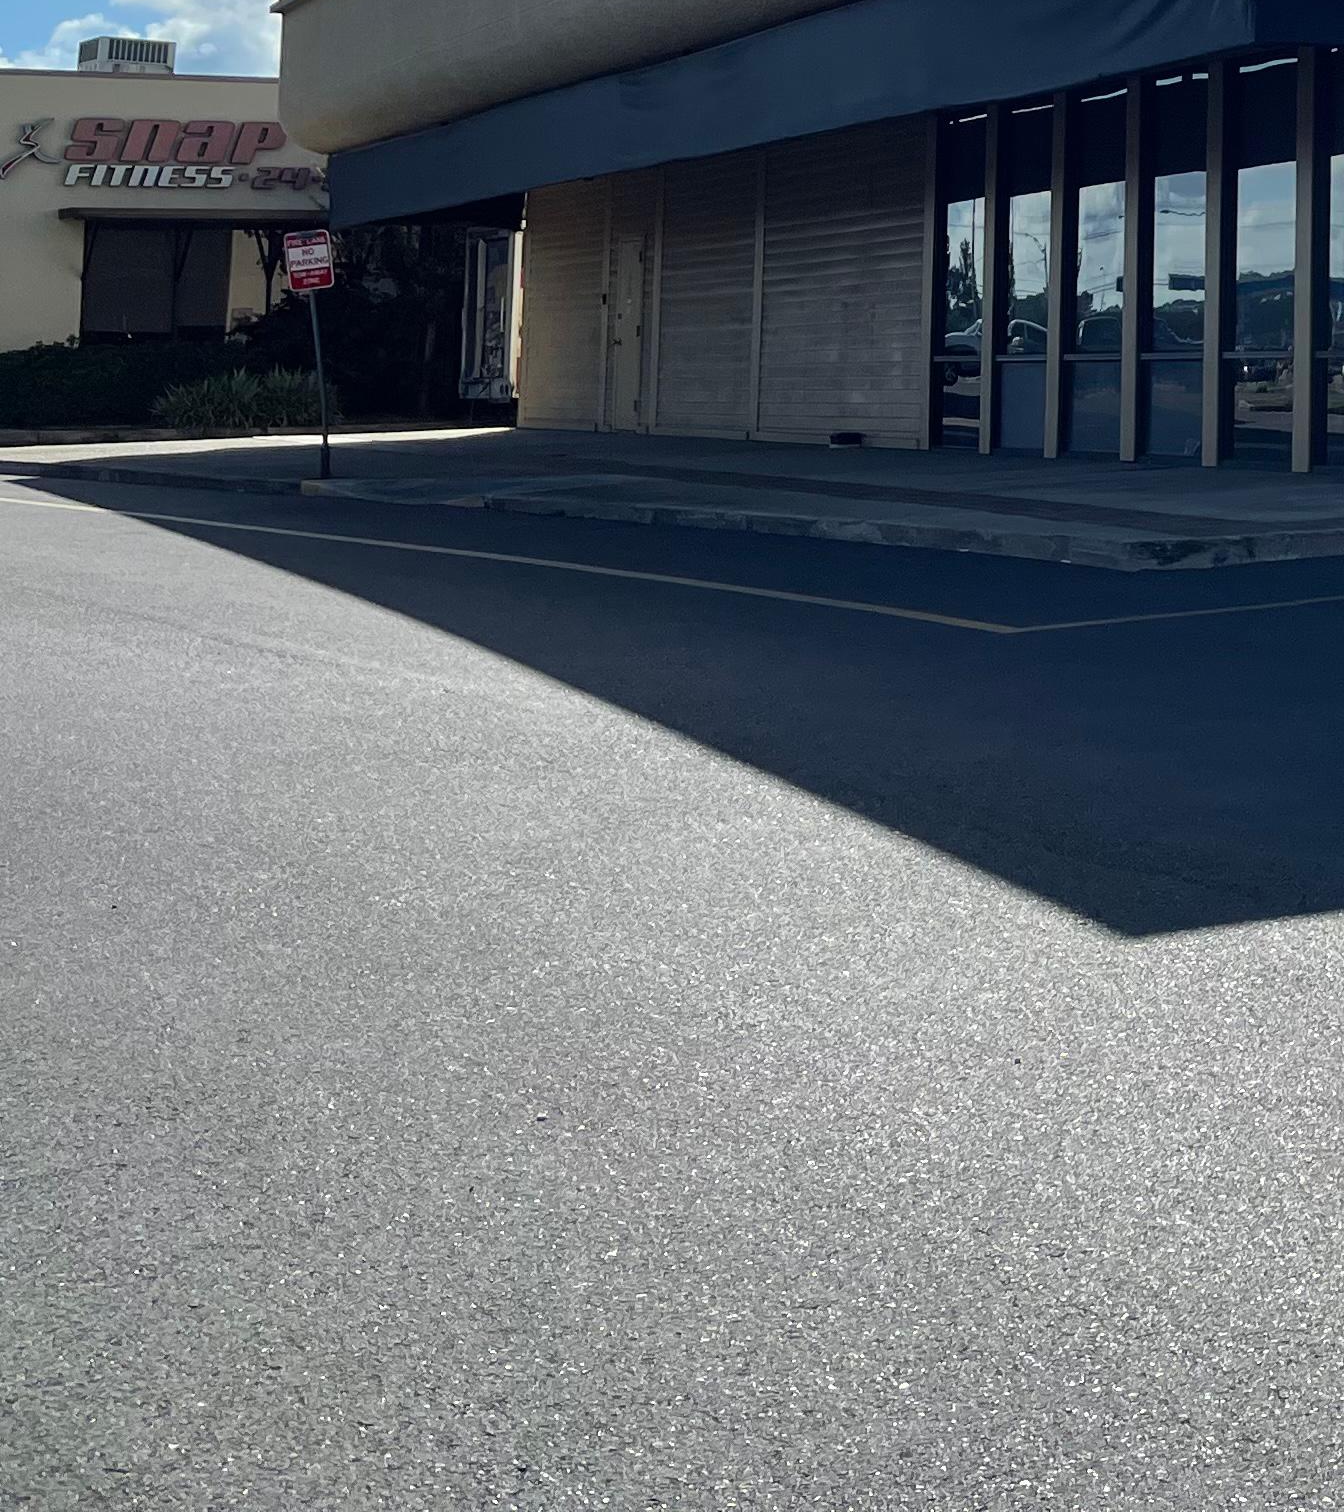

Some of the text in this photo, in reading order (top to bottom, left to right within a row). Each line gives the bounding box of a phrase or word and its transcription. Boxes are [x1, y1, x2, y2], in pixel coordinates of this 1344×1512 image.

[63, 163, 237, 189] FITNESS
[302, 248, 314, 256] NO
[290, 256, 329, 267] PARKING
